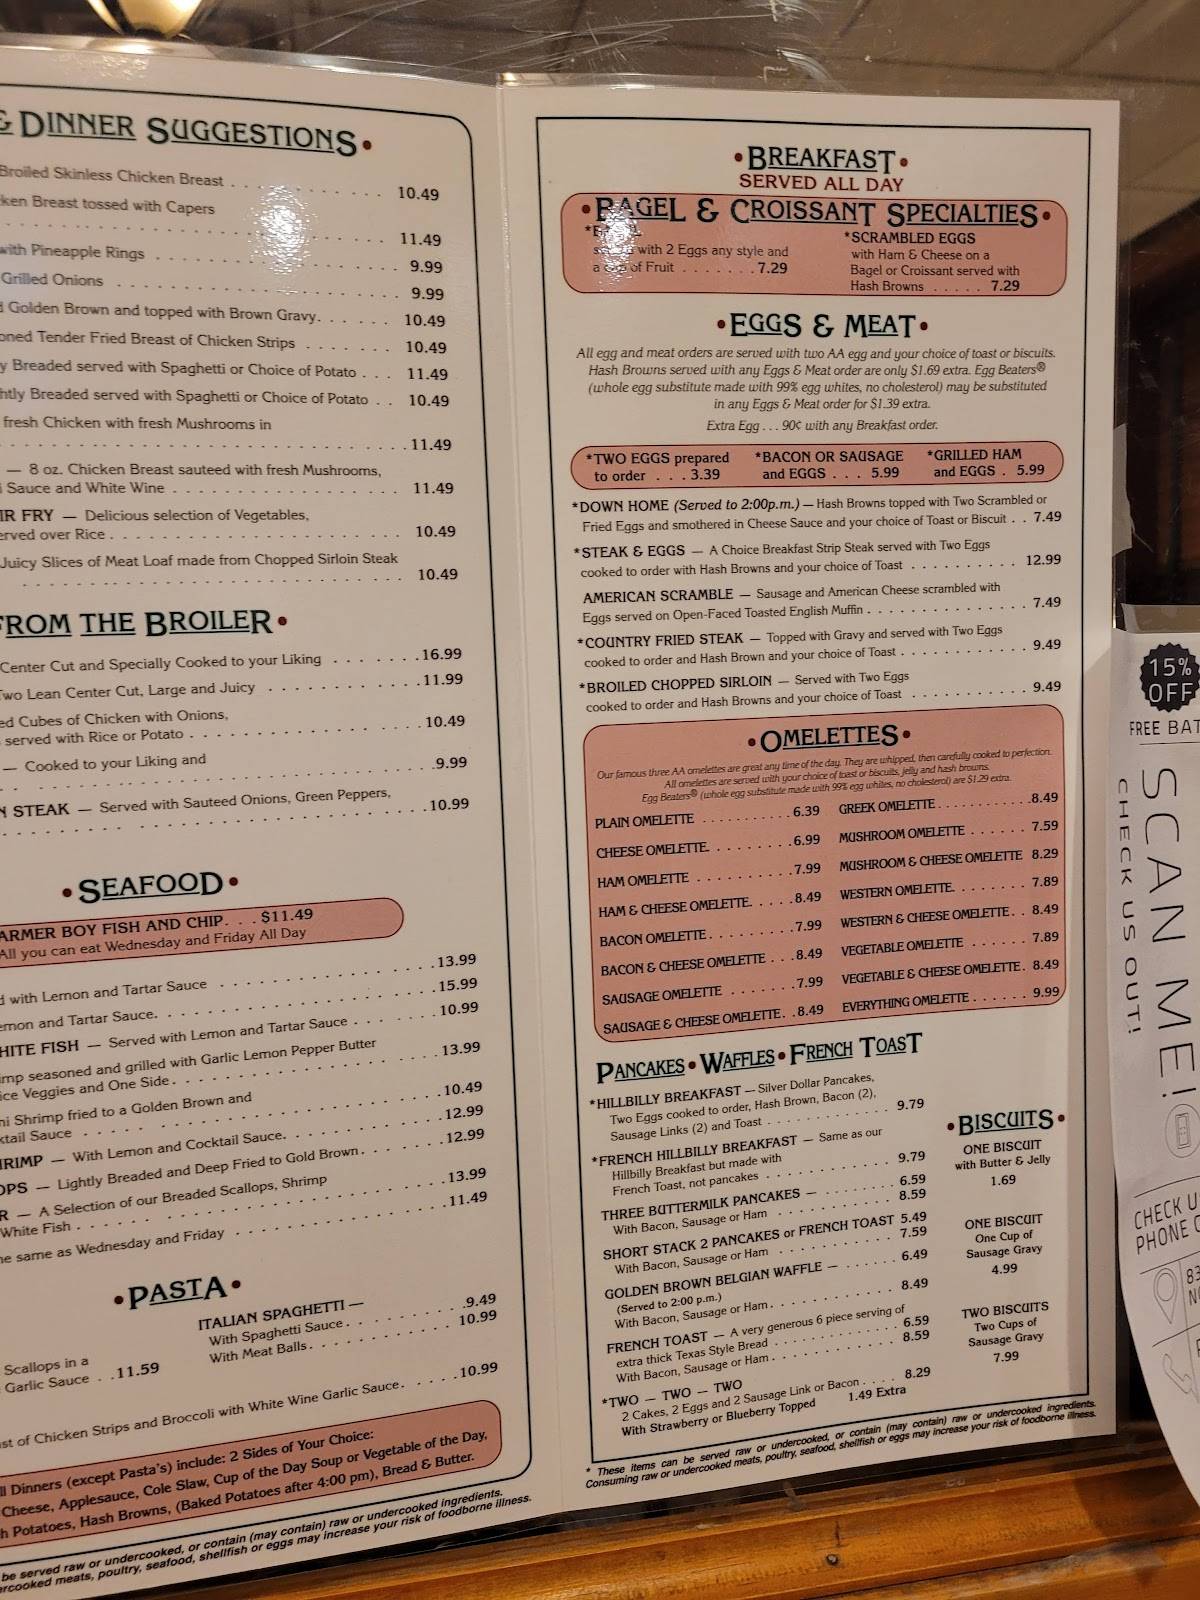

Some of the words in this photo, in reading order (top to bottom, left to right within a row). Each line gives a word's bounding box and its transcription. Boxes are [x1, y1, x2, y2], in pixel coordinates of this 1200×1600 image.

[18, 110, 137, 141] DINNER
[146, 117, 357, 157] SUGGESTIONS
[747, 145, 896, 175] BREAKFAST
[0, 164, 49, 178] Broiled
[53, 166, 113, 181] Skinless
[117, 169, 175, 184] Chicken
[179, 172, 224, 187] Breast
[398, 186, 439, 201] 10.49
[739, 173, 817, 190] SERVED
[824, 177, 860, 191] ALL
[866, 178, 904, 192] DAY
[32, 195, 79, 209] Breast
[82, 198, 128, 211] tossed
[133, 200, 162, 212] with
[166, 200, 215, 217] Capers
[696, 197, 720, 223] &
[730, 198, 876, 227] CROISSANT
[887, 203, 1038, 228] SPECIALTIES
[400, 232, 442, 247] 11.49
[939, 232, 976, 244] EGGS
[31, 243, 101, 260] Pineapple
[105, 246, 145, 262] Rings
[409, 259, 443, 274] 9.99
[1, 272, 48, 285] Grilled
[52, 273, 104, 287] Onions
[411, 287, 444, 301] 9.99
[850, 280, 879, 291] Hash
[882, 280, 924, 292] Browns
[991, 280, 1020, 292] 7.29
[729, 312, 802, 338] EGGS
[813, 313, 835, 338] &
[843, 314, 916, 338] MEAT
[3, 416, 39, 428] fresh
[42, 416, 101, 428] Chicken
[105, 417, 134, 429] with
[138, 417, 172, 429] fresh
[176, 417, 256, 430] Mushrooms
[259, 418, 272, 430] in
[706, 420, 739, 431] Extra
[741, 420, 761, 434] Egg
[805, 420, 829, 431] with
[832, 422, 853, 433] any
[856, 419, 906, 431] Breakfast
[411, 438, 452, 451] 11.49
[815, 451, 835, 463] OR
[839, 450, 904, 462] SAUSAGE
[7, 482, 51, 494] Sauce
[55, 482, 82, 494] and
[85, 482, 126, 493] White
[129, 481, 165, 494] Wine
[413, 482, 454, 494] 11.49
[762, 468, 785, 480] and
[789, 467, 826, 479] EGGS
[871, 466, 900, 479] 5.99
[583, 590, 656, 604] AMERICAN
[660, 588, 734, 602] SCRAMBLE
[0, 612, 73, 639] ROM
[78, 612, 136, 635] THE
[144, 609, 274, 637] BROILER
[0, 662, 46, 674] Center
[49, 660, 75, 672] Cut
[79, 659, 105, 671] and
[109, 657, 171, 673] Specially
[175, 656, 228, 668] Cooked
[231, 657, 245, 667] to
[248, 657, 279, 669] your
[282, 653, 321, 667] Liking
[422, 648, 462, 661] 16.99
[1149, 657, 1192, 677] 15%
[1148, 682, 1194, 703] OFF
[760, 724, 899, 753] OMELETTES
[1129, 720, 1161, 736] FREE
[594, 816, 630, 829] PLAIN
[632, 813, 695, 827] OMELETTE
[793, 805, 820, 817] 6.39
[1118, 778, 1133, 886] CHECK
[839, 857, 906, 872] MUSHROOM
[908, 856, 917, 867] &
[919, 853, 963, 866] CHEESE
[964, 850, 1023, 863] OMELETTE
[1031, 848, 1059, 860] 8.29
[1142, 768, 1186, 942] SCAN
[78, 871, 224, 904] SEAFOOD
[61, 924, 97, 938] BOY
[102, 921, 141, 935] FISH
[145, 918, 181, 932] AND
[261, 908, 314, 924] $11.49
[1122, 901, 1136, 942] US
[0, 948, 16, 960] All
[20, 949, 47, 962] you
[50, 947, 76, 956] can
[80, 944, 102, 954] eat
[104, 937, 181, 952] Wednesday
[185, 933, 210, 946] and
[214, 931, 255, 944] Friday
[259, 928, 277, 940] All
[281, 928, 306, 940] Day
[9, 992, 38, 1004] with
[42, 991, 90, 1002] Lemon
[93, 985, 119, 998] and
[122, 984, 163, 996] Tartar
[166, 981, 207, 992] Sauce
[438, 953, 477, 968] 13.99
[842, 996, 910, 1013] EVERYTHING
[912, 992, 970, 1007] OMELETTE
[1033, 986, 1060, 998] 9.99
[1125, 957, 1141, 1034] OUT!
[1156, 979, 1197, 1098] ME!
[596, 1058, 686, 1085] PANCAKES
[699, 1048, 776, 1075] WAFFLES
[789, 1041, 853, 1066] FRENCH
[858, 1032, 923, 1058] TOAST
[958, 1109, 1054, 1136] BISCUITS
[963, 1143, 990, 1155] ONE
[993, 1139, 1042, 1153] BISCUIT
[991, 1174, 1016, 1186] 1.69
[600, 1206, 645, 1221] THREE
[648, 1197, 729, 1216] BUTTERMILK
[733, 1188, 801, 1207] PANCAKES
[899, 1173, 926, 1186] 6.59
[1134, 1196, 1182, 1230] CHECK
[1136, 1218, 1189, 1255] PHONE
[604, 1283, 659, 1300] GOLDEN
[663, 1276, 712, 1293] BROWN
[715, 1268, 770, 1286] BELGIAN
[773, 1261, 823, 1278] WAFFLE
[902, 1249, 928, 1261] 6.49
[128, 1276, 229, 1310] PASTA
[198, 1312, 258, 1331] ITALIAN
[262, 1299, 345, 1322] SPAGHETTI
[208, 1333, 238, 1346] With
[241, 1325, 301, 1343] Spaghetti
[465, 1293, 496, 1308] 9.49
[382, 1460, 418, 1477] Bread
[421, 1458, 432, 1470] &
[597, 1466, 626, 1477] These
[630, 1462, 656, 1473] items
[661, 1459, 678, 1468] can
[683, 1455, 695, 1465] be
[699, 1448, 731, 1462] served
